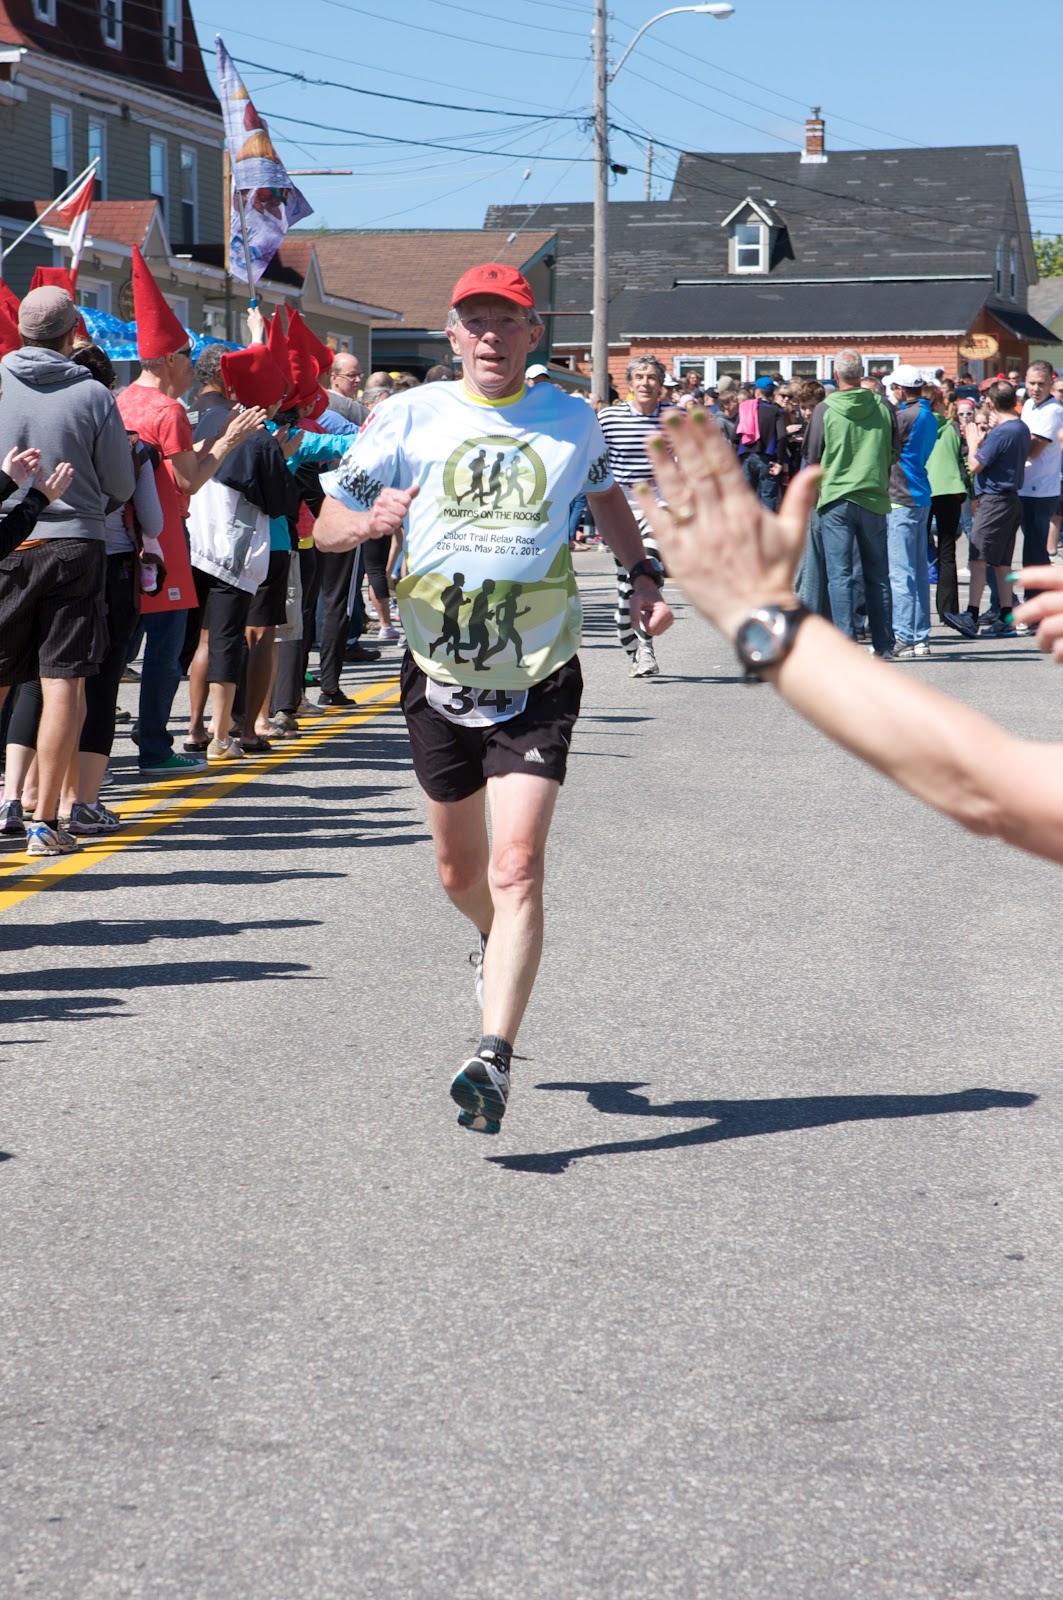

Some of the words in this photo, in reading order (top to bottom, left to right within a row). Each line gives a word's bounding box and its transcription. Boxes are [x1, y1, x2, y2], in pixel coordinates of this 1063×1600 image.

[443, 508, 479, 519] MOJITOS
[480, 510, 493, 519] ON
[495, 510, 512, 519] THE
[513, 511, 541, 521] ROCKS
[443, 531, 467, 540] Cabot
[469, 533, 488, 542] Trail
[490, 534, 514, 544] Relay
[515, 536, 535, 545] Race
[436, 542, 451, 551] 276
[453, 543, 472, 552] kms.
[474, 544, 493, 553] May
[520, 547, 540, 556] 2012
[442, 682, 512, 716] 34
